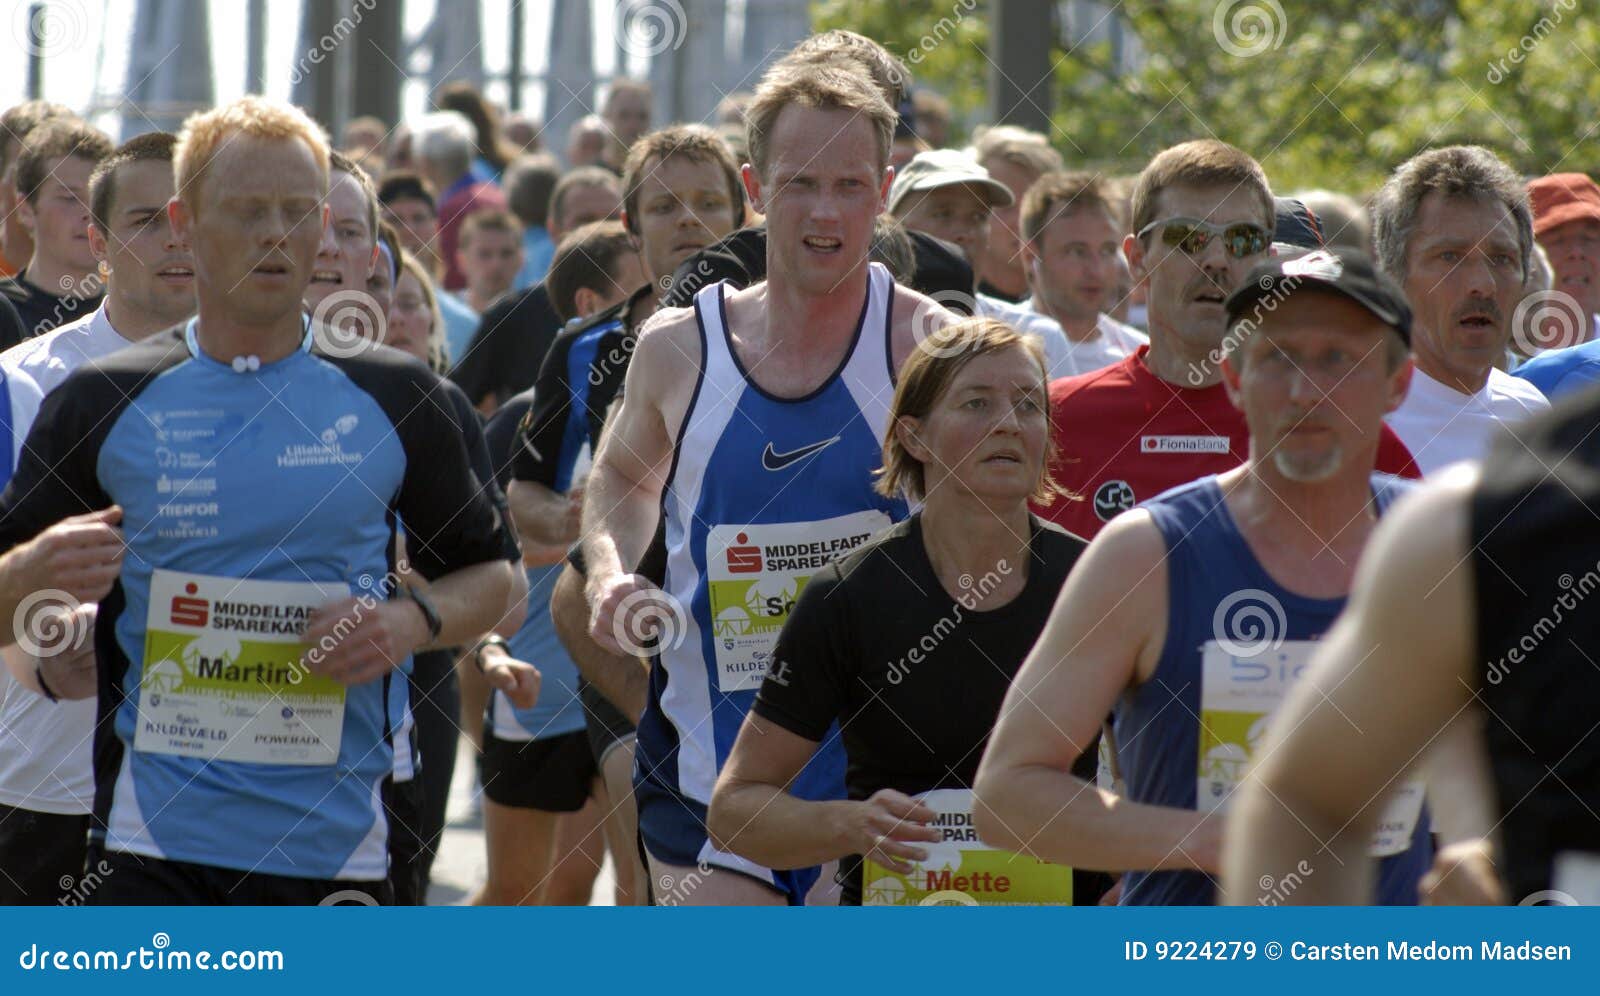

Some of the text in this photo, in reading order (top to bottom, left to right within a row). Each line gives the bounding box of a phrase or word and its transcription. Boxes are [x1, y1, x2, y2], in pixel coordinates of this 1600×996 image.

[765, 533, 871, 558] MIDDELFART
[213, 617, 311, 635] SPAREKAS
[198, 656, 292, 685] Martin
[726, 661, 771, 673] KILDE
[926, 870, 1011, 893] Mette
